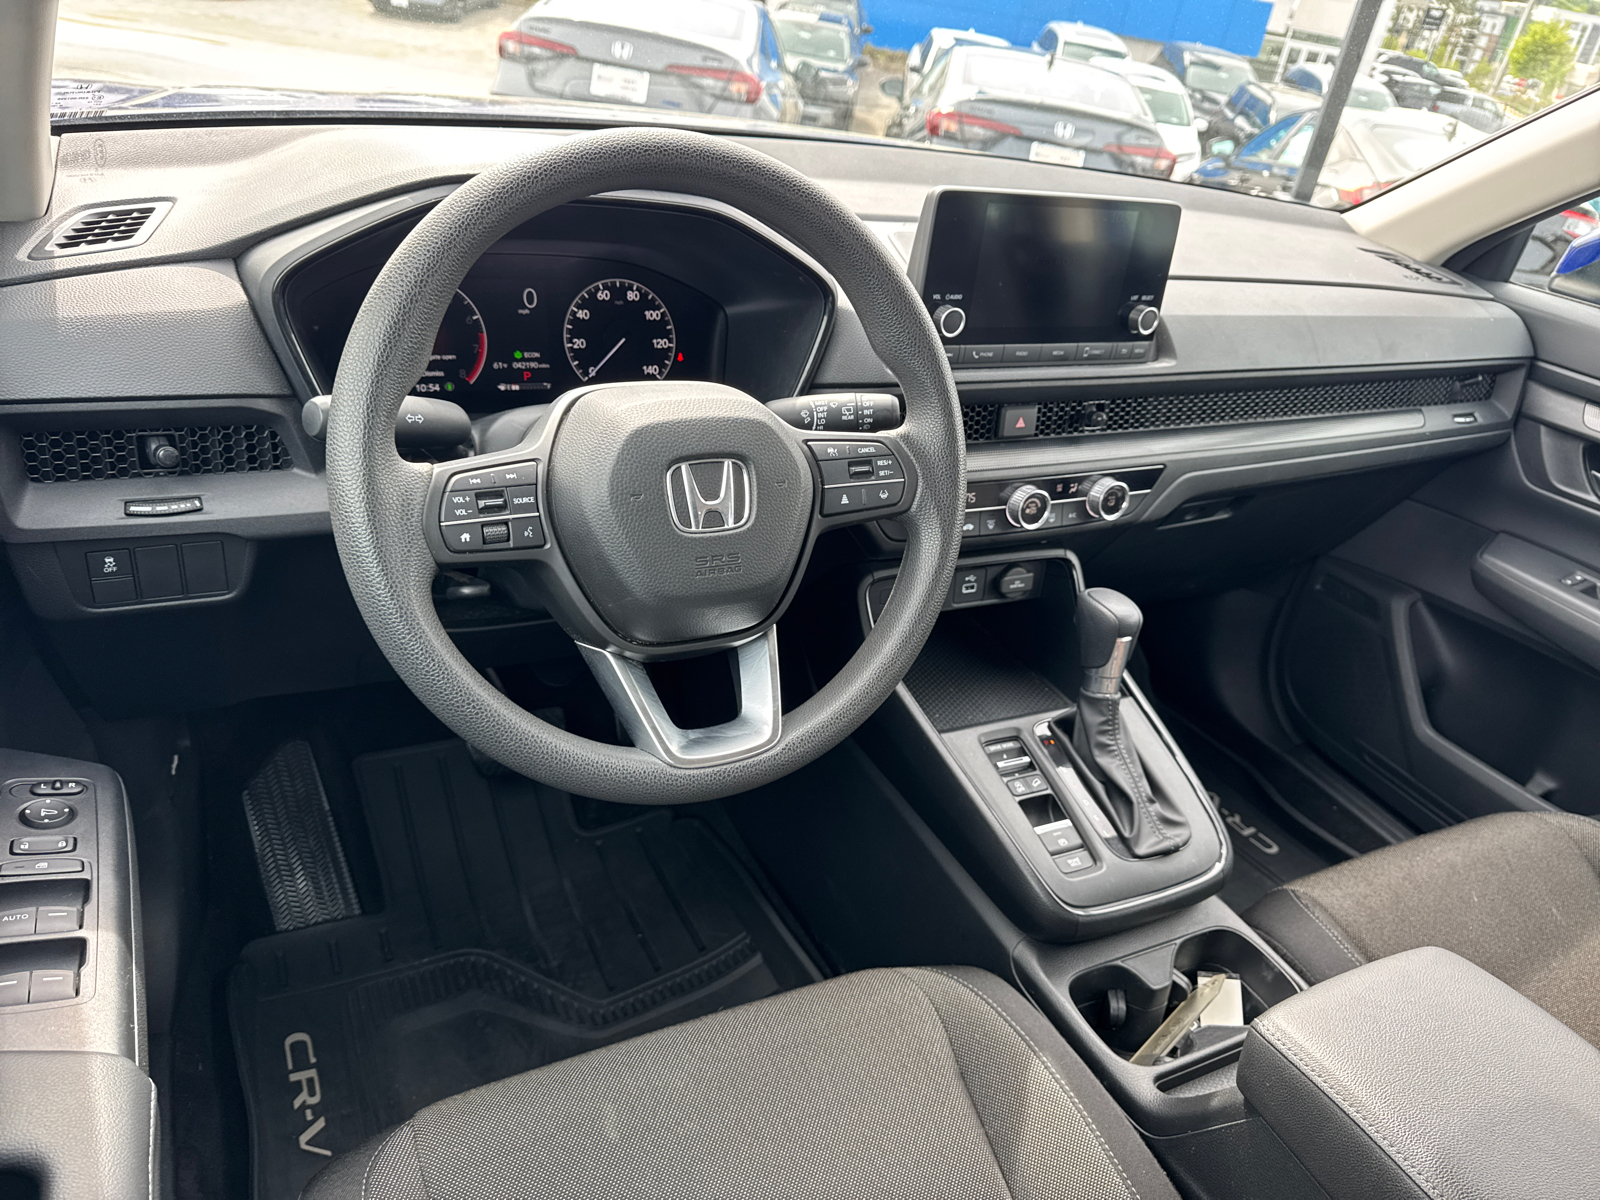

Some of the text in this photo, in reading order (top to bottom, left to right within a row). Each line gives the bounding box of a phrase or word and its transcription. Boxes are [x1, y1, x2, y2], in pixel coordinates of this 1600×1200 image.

[523, 288, 538, 309] 0
[597, 290, 611, 301] 60
[627, 290, 640, 301] 80
[576, 309, 590, 320] 40
[644, 310, 661, 321] 100
[572, 338, 586, 349] 20
[652, 338, 669, 349] 120
[523, 351, 541, 359] ECON
[642, 365, 659, 376] 140
[523, 371, 532, 382] P
[415, 383, 441, 393] 10:54
[857, 446, 877, 454] CANCEL
[512, 496, 535, 505] SOURCE
[694, 552, 742, 567] SRS
[694, 565, 743, 579] AIRBAG
[2, 913, 29, 922] AUTO
[284, 1031, 333, 1157] CR-V
